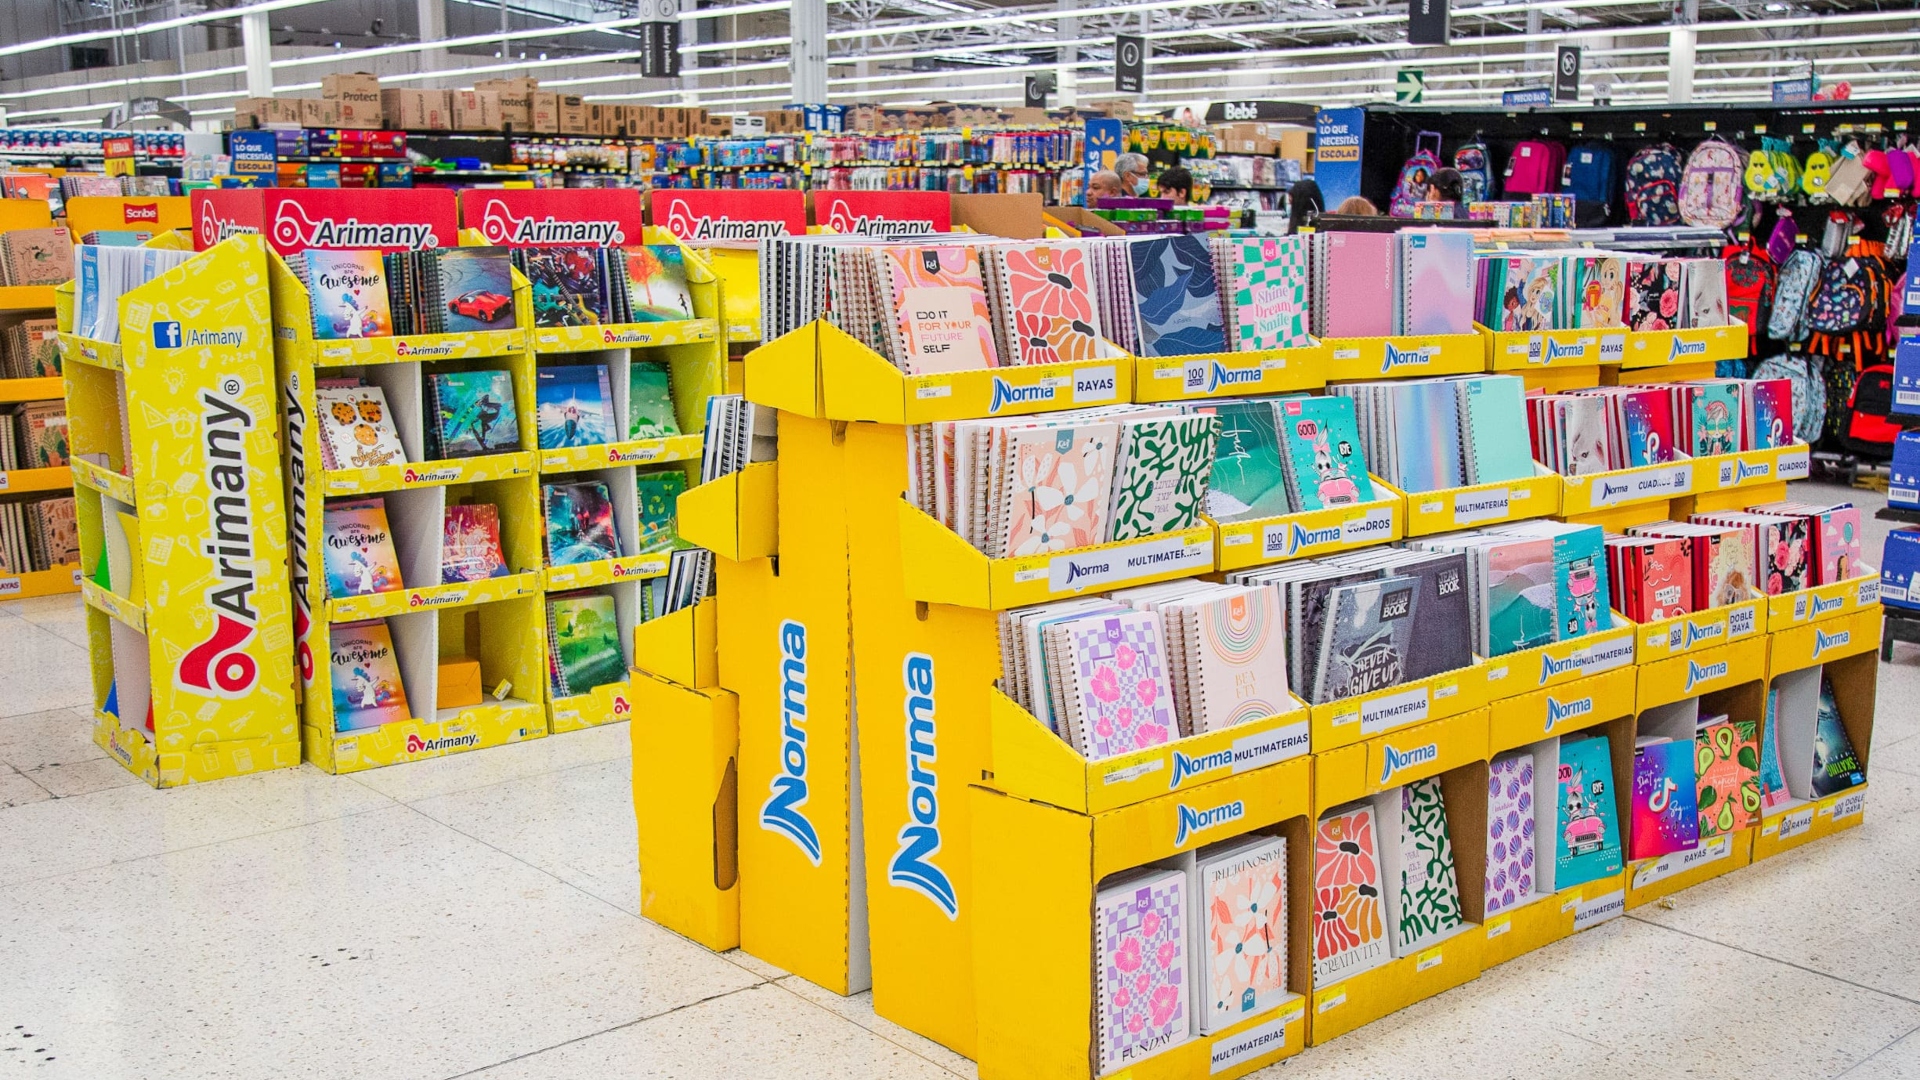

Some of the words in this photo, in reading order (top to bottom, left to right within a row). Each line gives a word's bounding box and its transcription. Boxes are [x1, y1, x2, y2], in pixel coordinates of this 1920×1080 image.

[343, 92, 378, 102] Protect
[1224, 102, 1258, 120] Bebé
[1320, 126, 1330, 134] LO
[1332, 126, 1348, 134] QUE
[1320, 134, 1358, 146] NECESITÁS
[236, 152, 273, 160] NECESITÁS
[1320, 150, 1358, 158] ESCOLAR
[126, 208, 156, 218] Scribe
[332, 262, 364, 272] UNICORNS
[1258, 286, 1288, 304] Shine
[916, 311, 936, 320] DO
[1256, 300, 1292, 317] Dream
[918, 322, 941, 330] FOR
[1259, 314, 1290, 332] Smile
[920, 332, 963, 342] FUTURE
[923, 344, 950, 354] SELF
[1530, 342, 1540, 351] 100
[1545, 338, 1583, 364] Norma
[1600, 344, 1623, 354] RAYAS
[1670, 336, 1705, 361] Norma
[1188, 367, 1204, 379] 100
[1209, 362, 1262, 392] Norma
[990, 378, 1054, 412] Norma
[1077, 378, 1114, 392] RAYAS
[1298, 423, 1317, 436] GOOD
[1674, 472, 1685, 482] 100
[1736, 460, 1768, 484] Norma
[1779, 461, 1807, 472] CUADROS
[1602, 482, 1628, 500] Norma
[1454, 499, 1508, 513] MULTIMATERIAS
[338, 522, 371, 532] UNICORNS
[1267, 532, 1282, 544] 100
[1289, 524, 1340, 555] Norma
[1066, 561, 1109, 584] Norma
[1438, 580, 1460, 595] BOOK
[1860, 582, 1879, 594] DOBLE
[1860, 593, 1876, 604] RAYA
[1383, 603, 1407, 618] BOOK
[1810, 596, 1842, 619] Norma
[1730, 610, 1753, 624] DOBLE
[1670, 629, 1682, 640] 100
[1732, 623, 1750, 634] RAYA
[341, 638, 373, 648] UNICORNS
[1813, 630, 1849, 658] Norma
[1356, 648, 1390, 673] NEVER
[1581, 646, 1633, 666] MULTIMATERIAS
[1382, 660, 1398, 684] UP
[1686, 660, 1726, 691] Norma
[1362, 700, 1426, 724] MULTIMATERIAS
[1545, 698, 1590, 730] Norma
[425, 734, 476, 752] Arimany
[764, 622, 820, 861] Norma
[1171, 750, 1232, 787] Norma
[1234, 733, 1308, 762] MULTIMATERIAS
[1381, 745, 1436, 781] Norma
[892, 657, 956, 914] Norma
[1592, 783, 1604, 794] BYE
[1845, 794, 1865, 806] DOBLE
[1846, 804, 1860, 814] RAYA
[1176, 801, 1242, 844] Norma
[1791, 816, 1812, 829] RAYAS
[1684, 849, 1706, 864] RAYAS
[1574, 899, 1624, 922] MULTIMATERIAS
[1319, 941, 1382, 976] CREATIVITY
[1122, 1031, 1172, 1062] FUNDAY
[1212, 1028, 1285, 1064] MULTIMATERIAS
